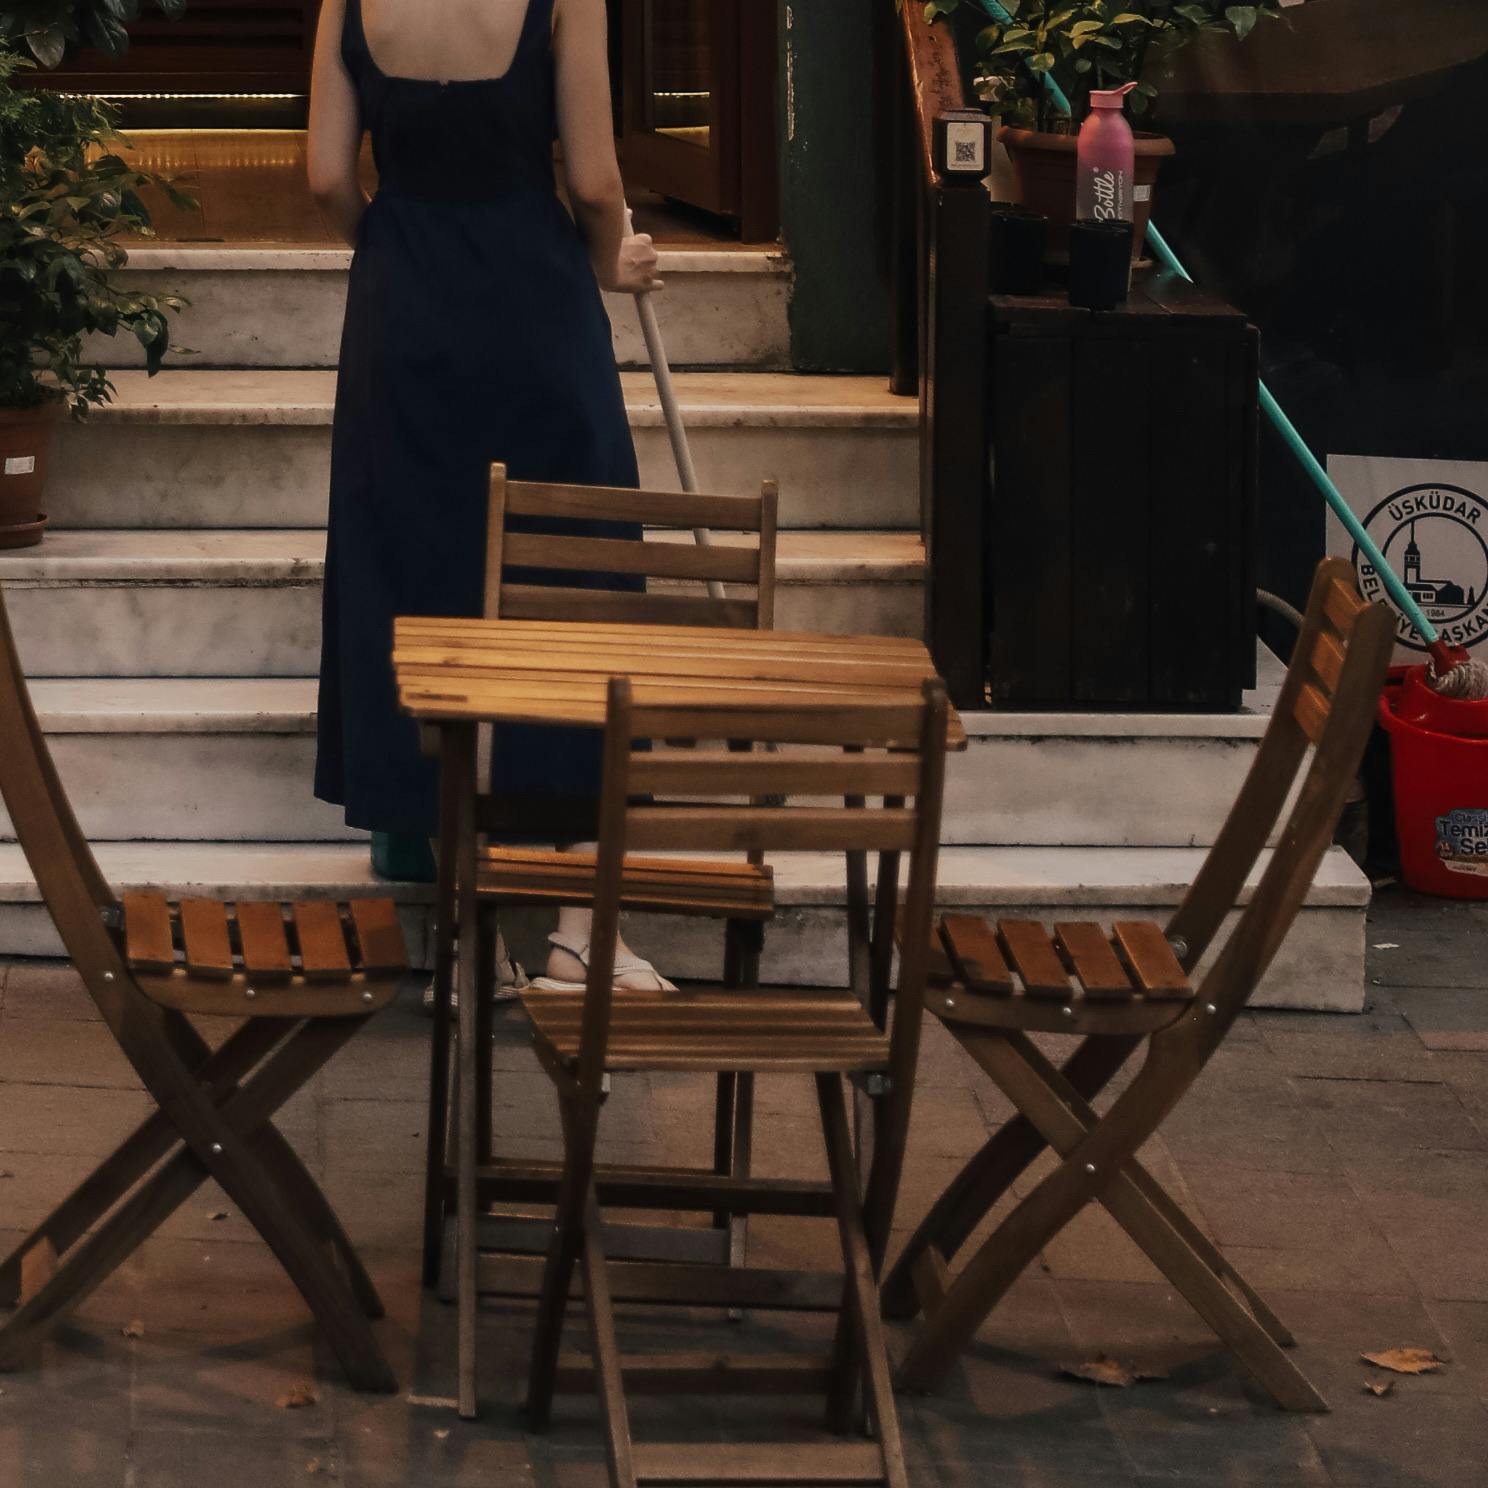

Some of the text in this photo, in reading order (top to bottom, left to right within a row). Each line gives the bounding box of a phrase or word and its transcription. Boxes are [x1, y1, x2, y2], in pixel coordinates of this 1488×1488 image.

[1093, 169, 1115, 223] Bottle
[1388, 490, 1481, 525] ÜSKÜDAR
[1460, 837, 1488, 855] Se
